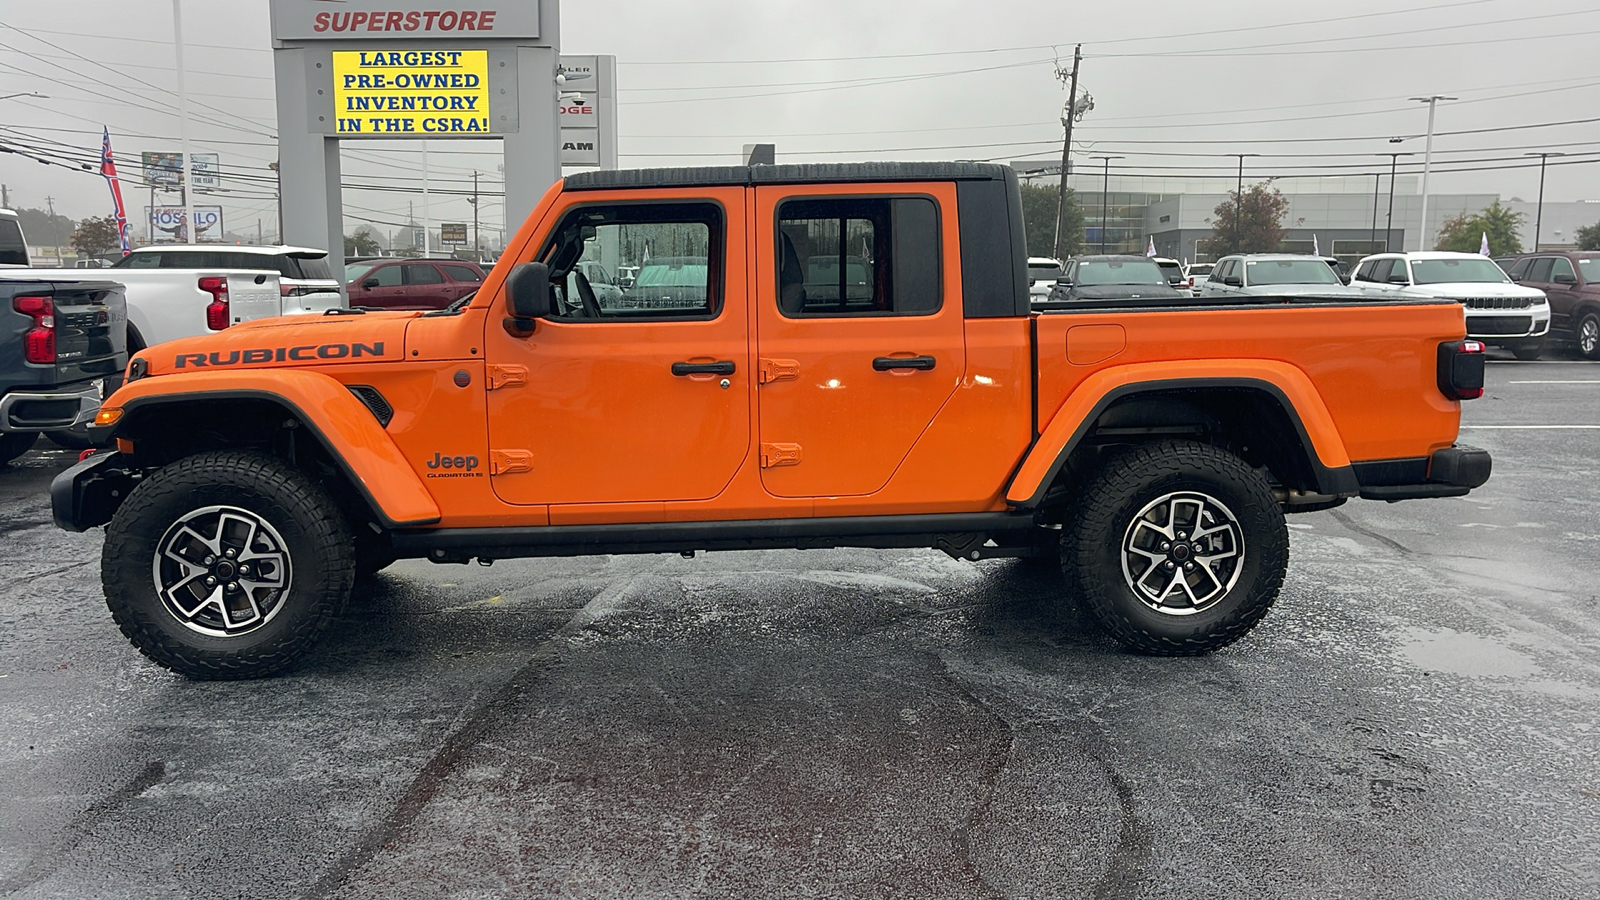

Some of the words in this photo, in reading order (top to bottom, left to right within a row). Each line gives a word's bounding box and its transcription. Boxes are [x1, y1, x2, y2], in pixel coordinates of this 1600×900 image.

[313, 10, 497, 32] SUPERSTORE
[359, 52, 462, 66] LARGEST
[343, 74, 480, 88] PRE-OWNED
[346, 95, 479, 110] INVENTORY
[338, 118, 361, 132] IN
[369, 118, 415, 132] THE
[422, 117, 489, 132] CSRA!
[174, 341, 385, 369] RUBICON
[427, 452, 479, 471] Jeep
